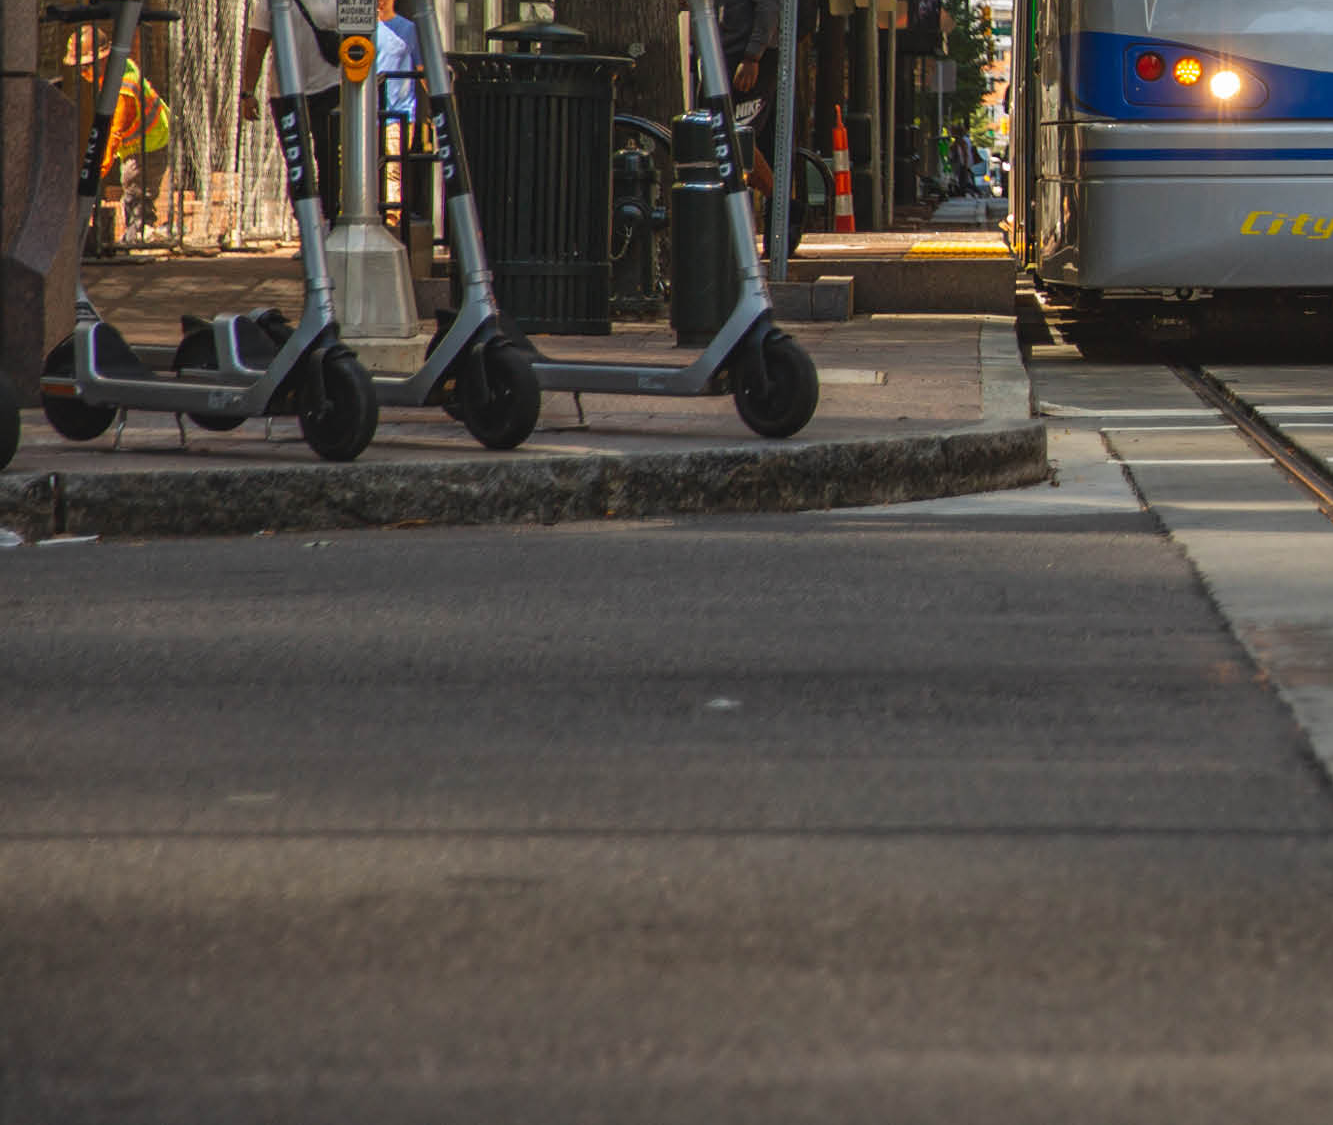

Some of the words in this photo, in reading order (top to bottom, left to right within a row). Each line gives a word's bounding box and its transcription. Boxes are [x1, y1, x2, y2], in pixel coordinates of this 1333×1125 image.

[281, 112, 303, 181] BIRD
[432, 113, 454, 179] BIRD
[712, 113, 732, 177] BIRD
